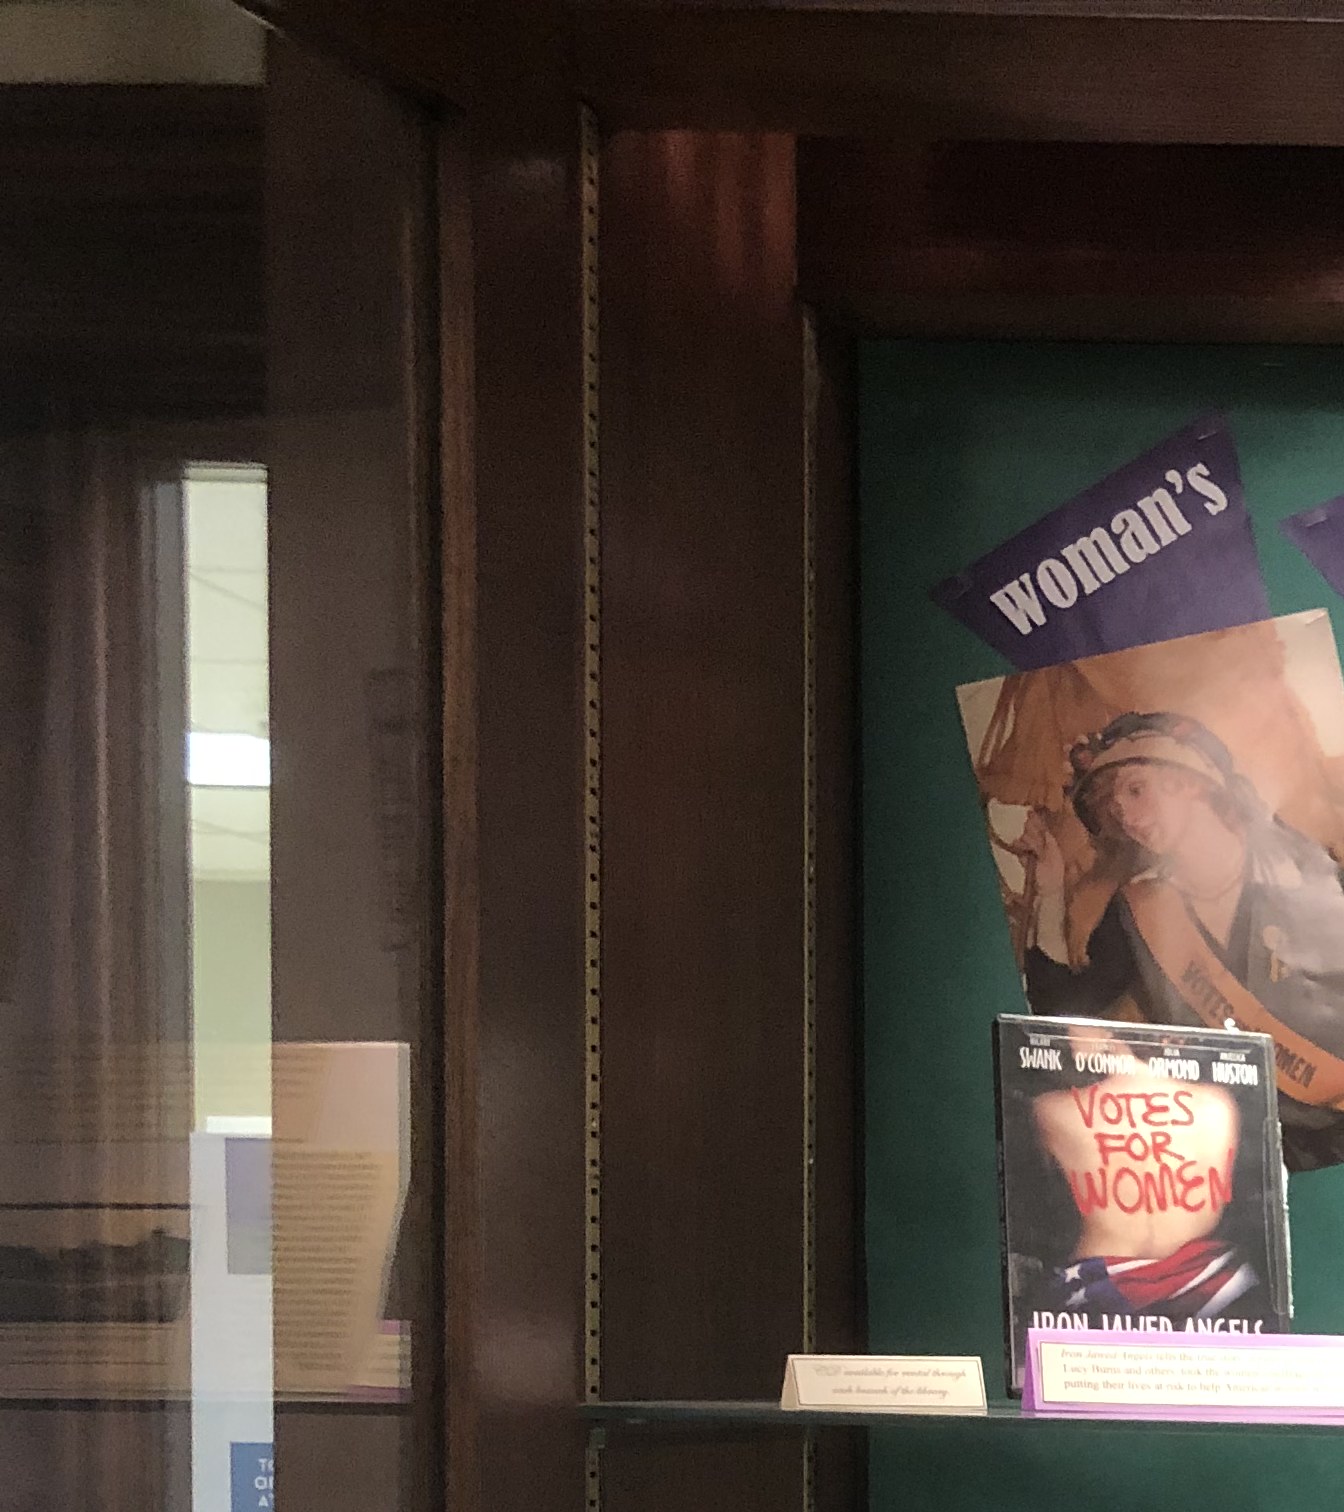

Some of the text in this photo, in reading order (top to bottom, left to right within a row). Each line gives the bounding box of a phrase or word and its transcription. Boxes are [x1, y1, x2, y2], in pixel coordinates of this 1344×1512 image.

[990, 462, 1229, 635] woman's
[1019, 1047, 1062, 1071] SWANK
[1075, 1052, 1137, 1076] O'CONNOR
[1149, 1056, 1199, 1081] ORMOND
[1212, 1061, 1258, 1085] HUSTON
[1071, 1085, 1194, 1128] VOTES
[1094, 1132, 1185, 1165] FOR
[1070, 1148, 1233, 1216] WOMEN
